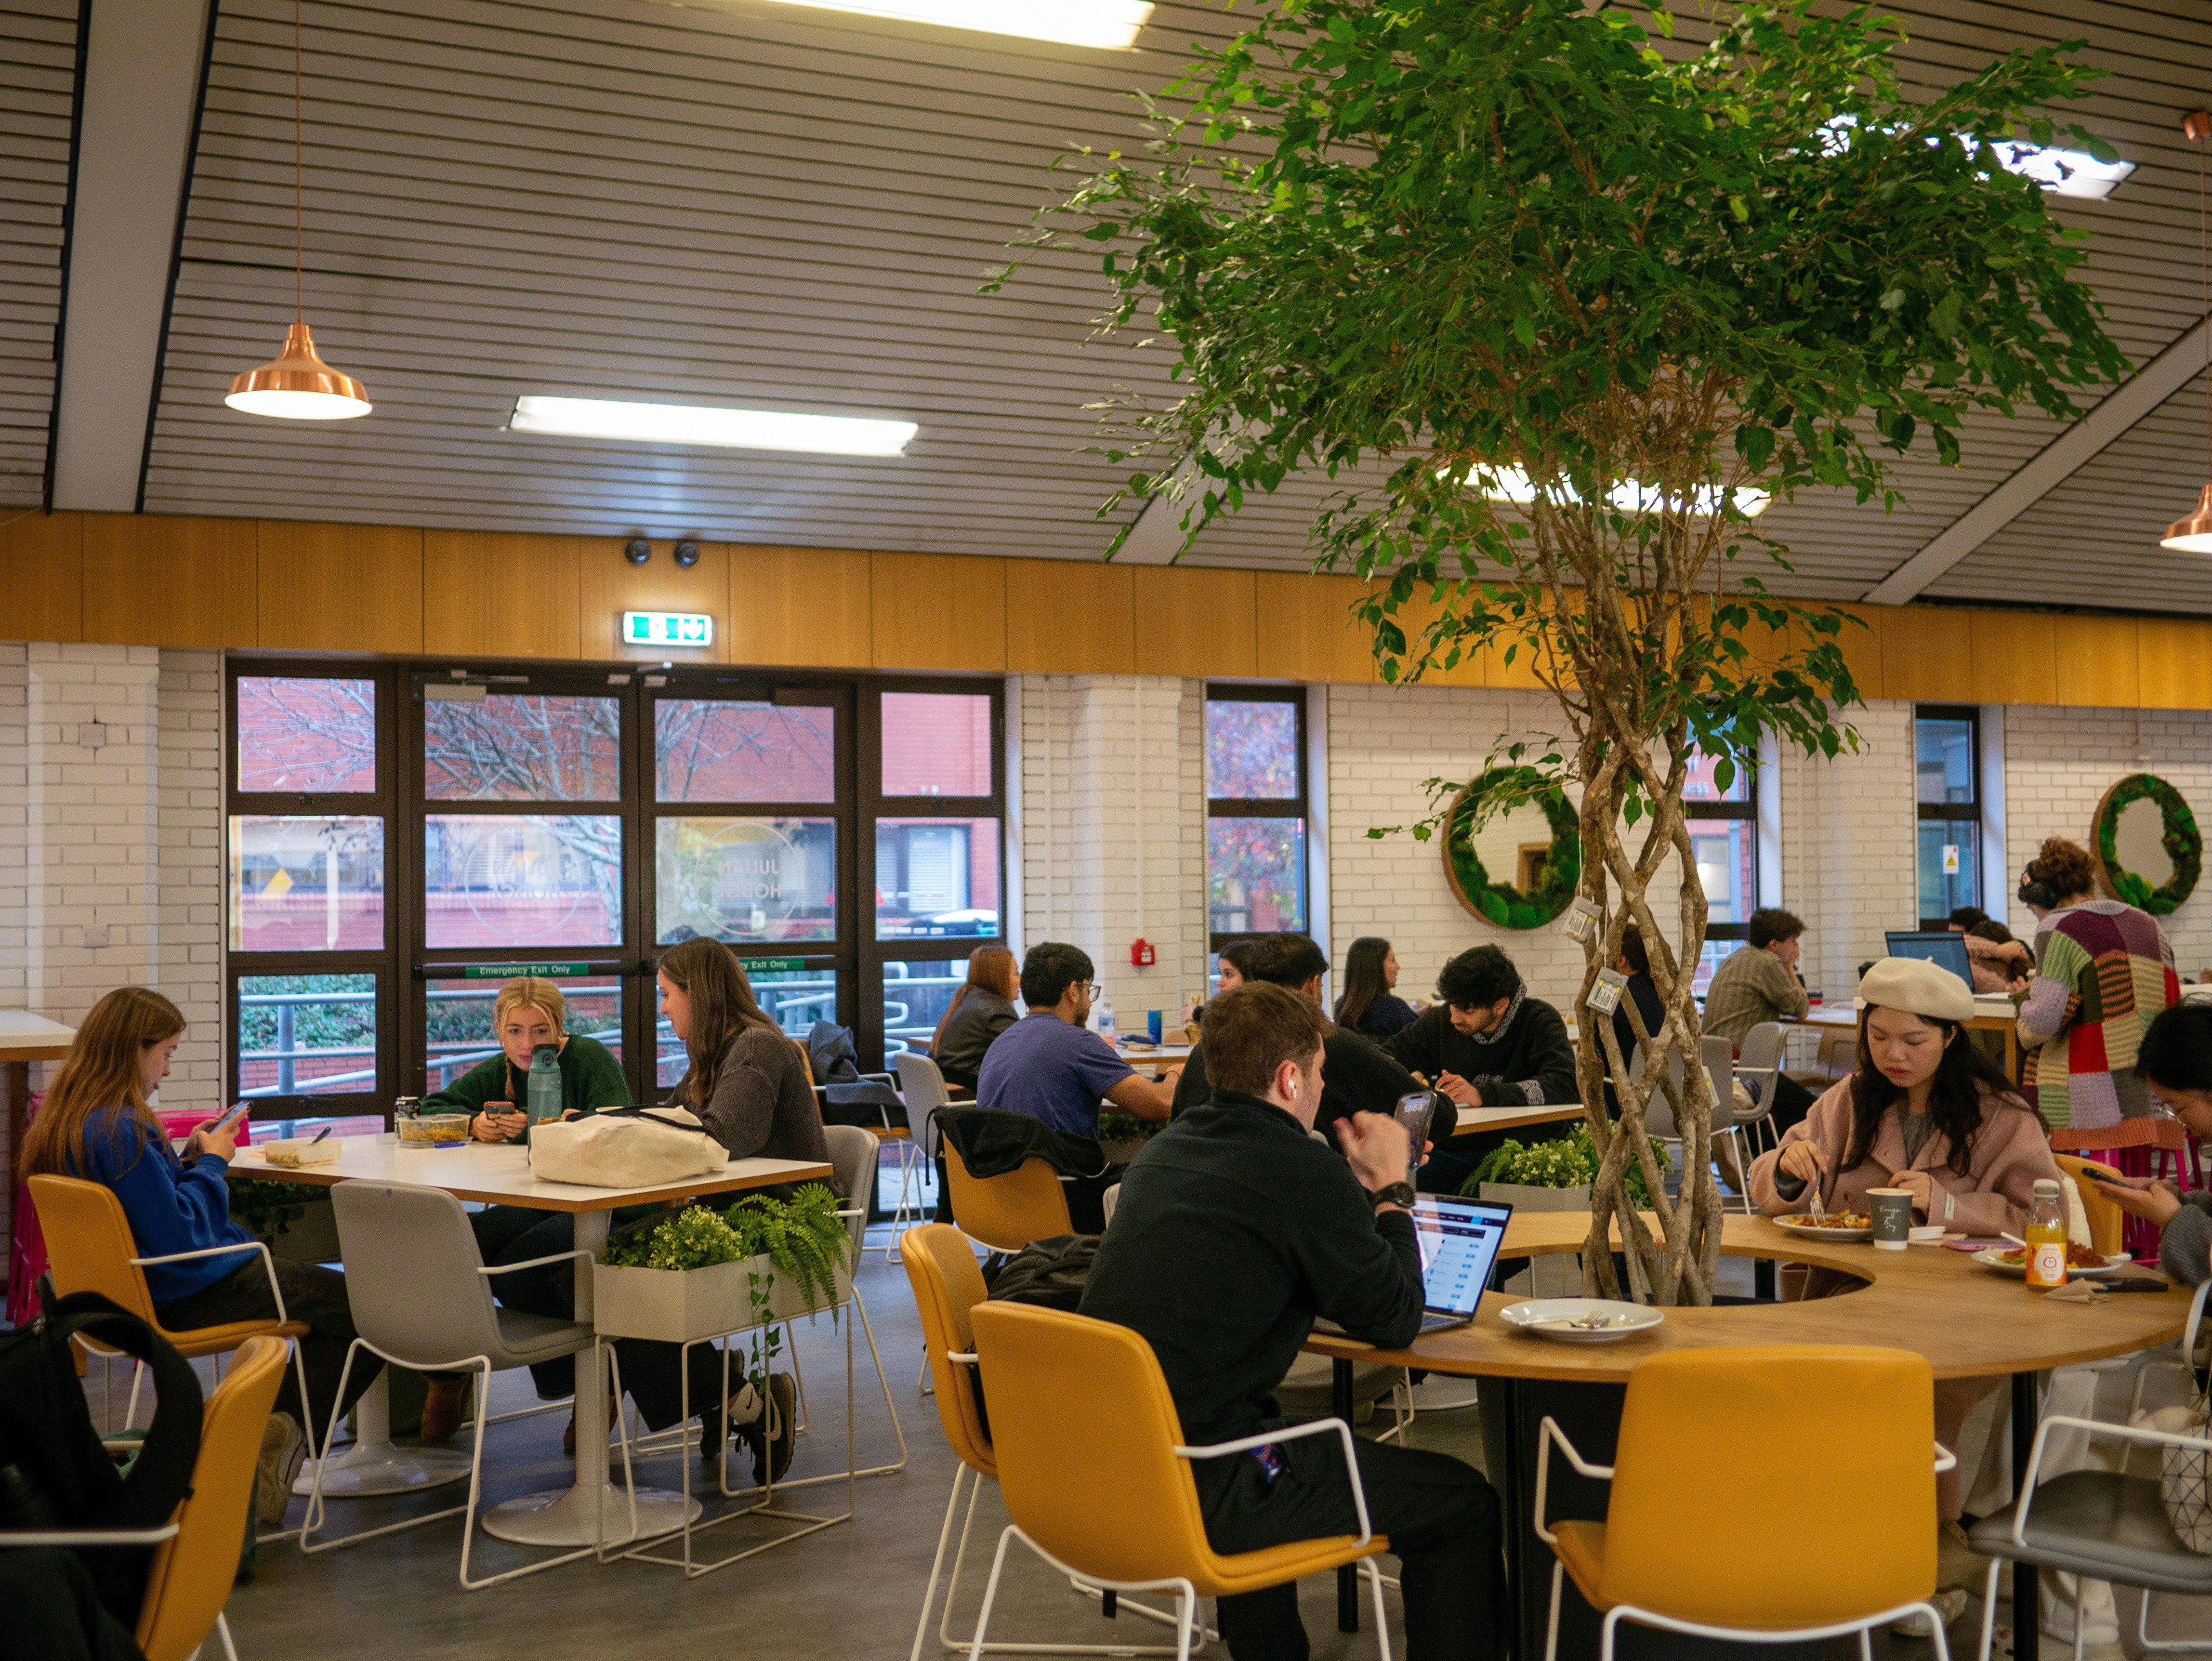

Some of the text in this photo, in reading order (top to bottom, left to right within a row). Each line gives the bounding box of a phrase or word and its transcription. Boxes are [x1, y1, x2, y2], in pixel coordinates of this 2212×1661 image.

[770, 960, 788, 969] Only
[480, 966, 528, 975] Emergency
[552, 965, 570, 974] Only
